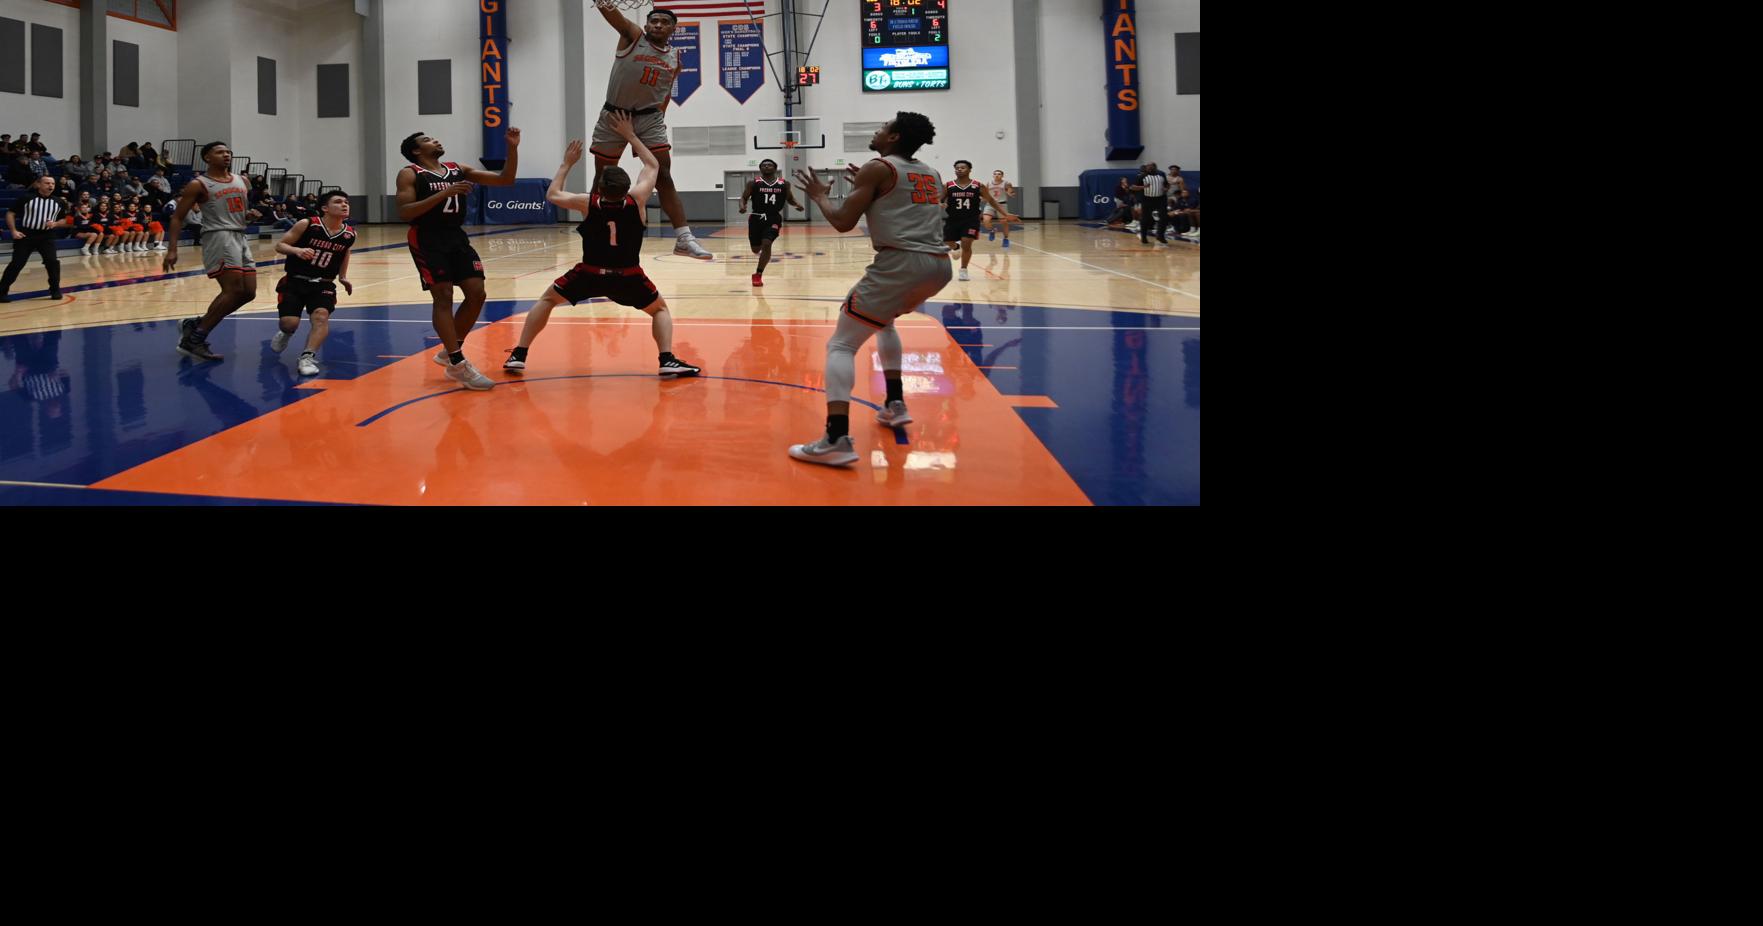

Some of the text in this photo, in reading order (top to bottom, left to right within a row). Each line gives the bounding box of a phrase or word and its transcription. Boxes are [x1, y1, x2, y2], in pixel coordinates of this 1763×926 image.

[874, 2, 881, 12] 3
[870, 21, 877, 29] 6
[932, 18, 940, 27] 6
[874, 36, 881, 44] 0
[934, 33, 941, 42] 2
[481, 0, 502, 128] GIANTS
[640, 66, 660, 87] 11
[799, 73, 816, 84] 27
[906, 172, 940, 205] 35
[764, 193, 776, 205] 14
[955, 198, 971, 210] 34
[1093, 194, 1110, 204] Go
[487, 200, 546, 210] Go Giants!
[606, 220, 618, 247] 1
[311, 249, 333, 268] 10
